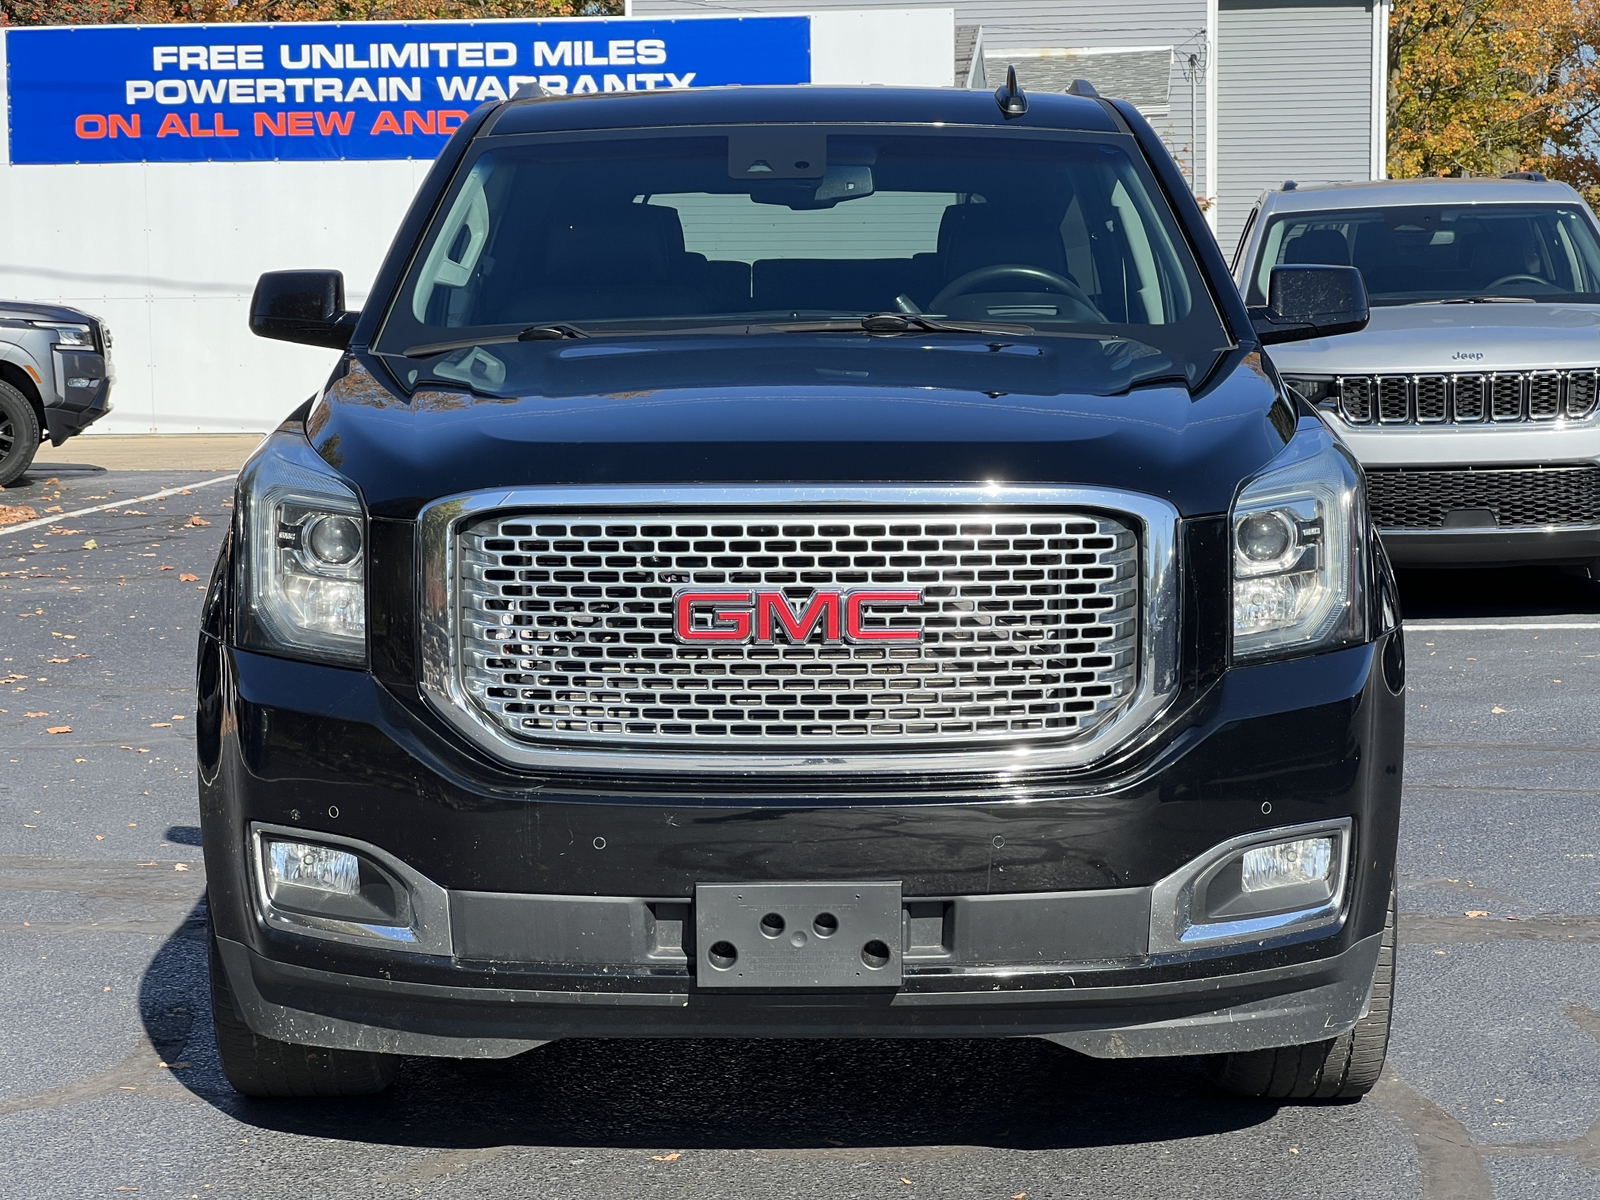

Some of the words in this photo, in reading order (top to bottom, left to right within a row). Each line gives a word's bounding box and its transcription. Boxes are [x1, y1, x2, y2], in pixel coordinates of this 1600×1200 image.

[153, 45, 264, 71] FREE
[280, 42, 517, 71] UNLIMITED
[533, 39, 667, 66] MILES
[125, 76, 421, 105] POWERTRAIN
[75, 113, 141, 139] ON
[157, 112, 239, 138] ALL
[254, 111, 356, 137] NEW
[370, 110, 469, 135] AND
[1451, 351, 1484, 361] Jeep
[672, 587, 925, 645] GMC
